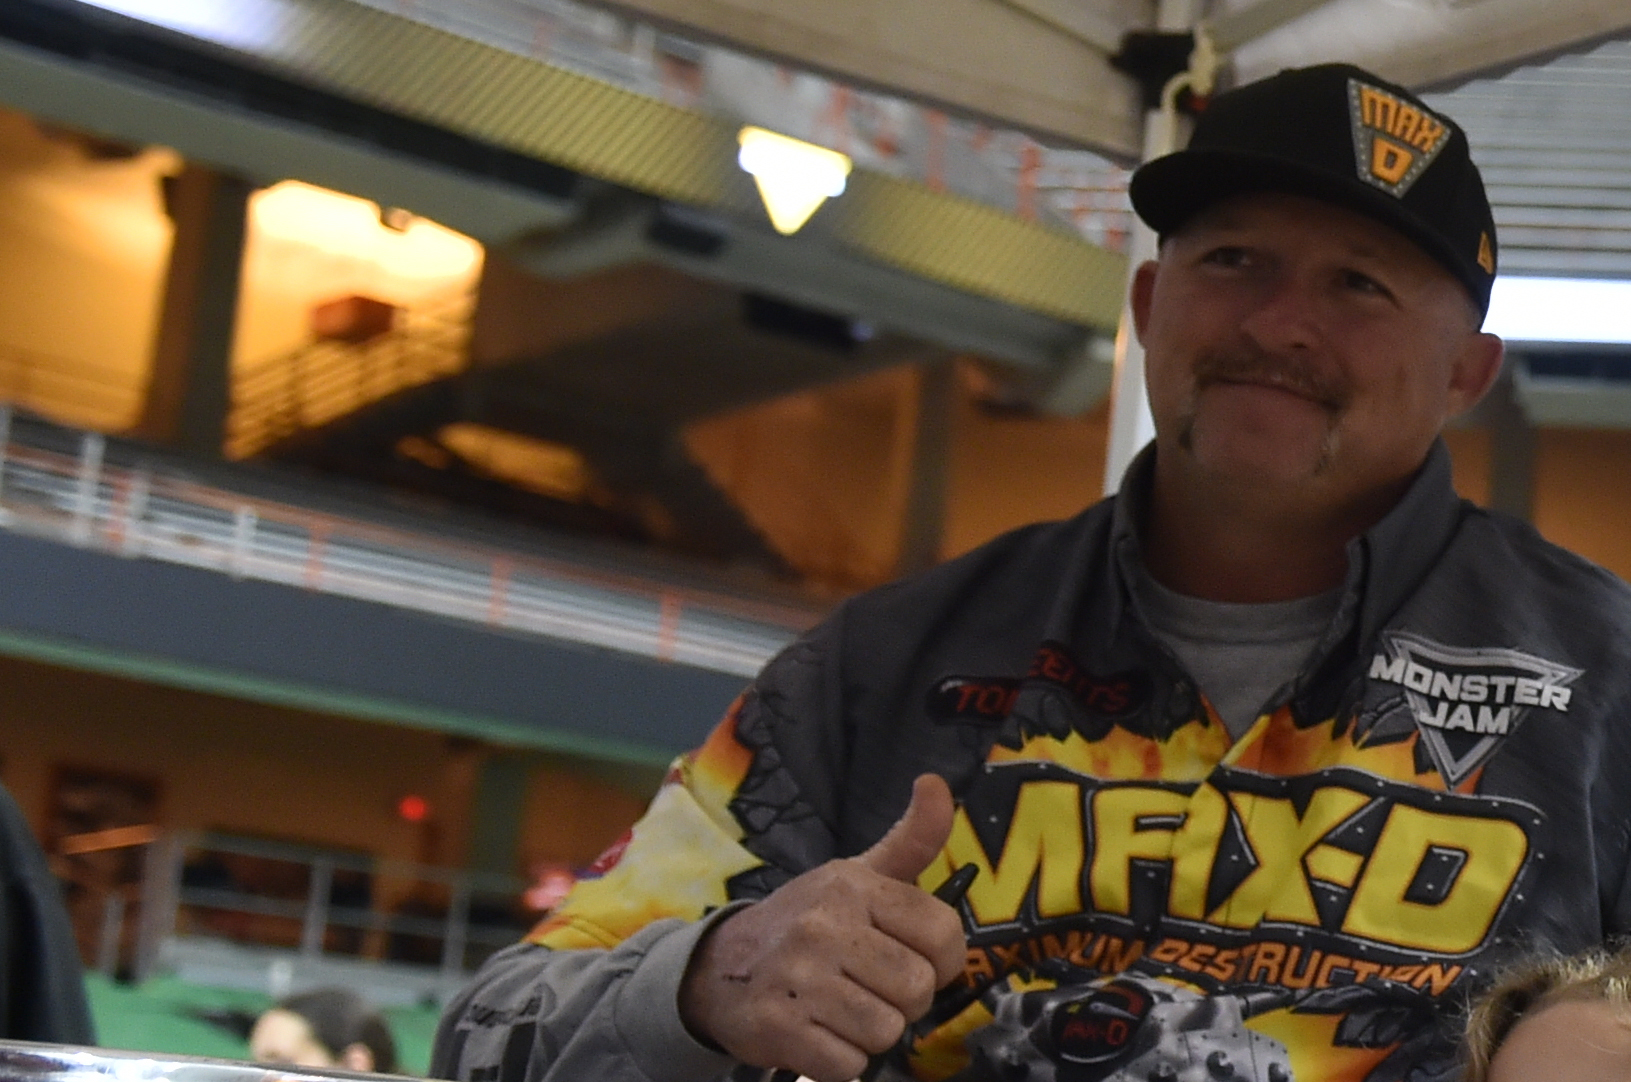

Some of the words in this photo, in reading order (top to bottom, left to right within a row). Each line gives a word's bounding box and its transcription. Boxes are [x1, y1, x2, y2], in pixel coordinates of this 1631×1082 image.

[1360, 86, 1446, 152] MAX
[1371, 136, 1413, 185] D
[1368, 653, 1573, 713] MONSTER
[1418, 701, 1512, 735] JAM
[917, 780, 1528, 953] MAX-D
[964, 930, 1146, 987] AXIMUM
